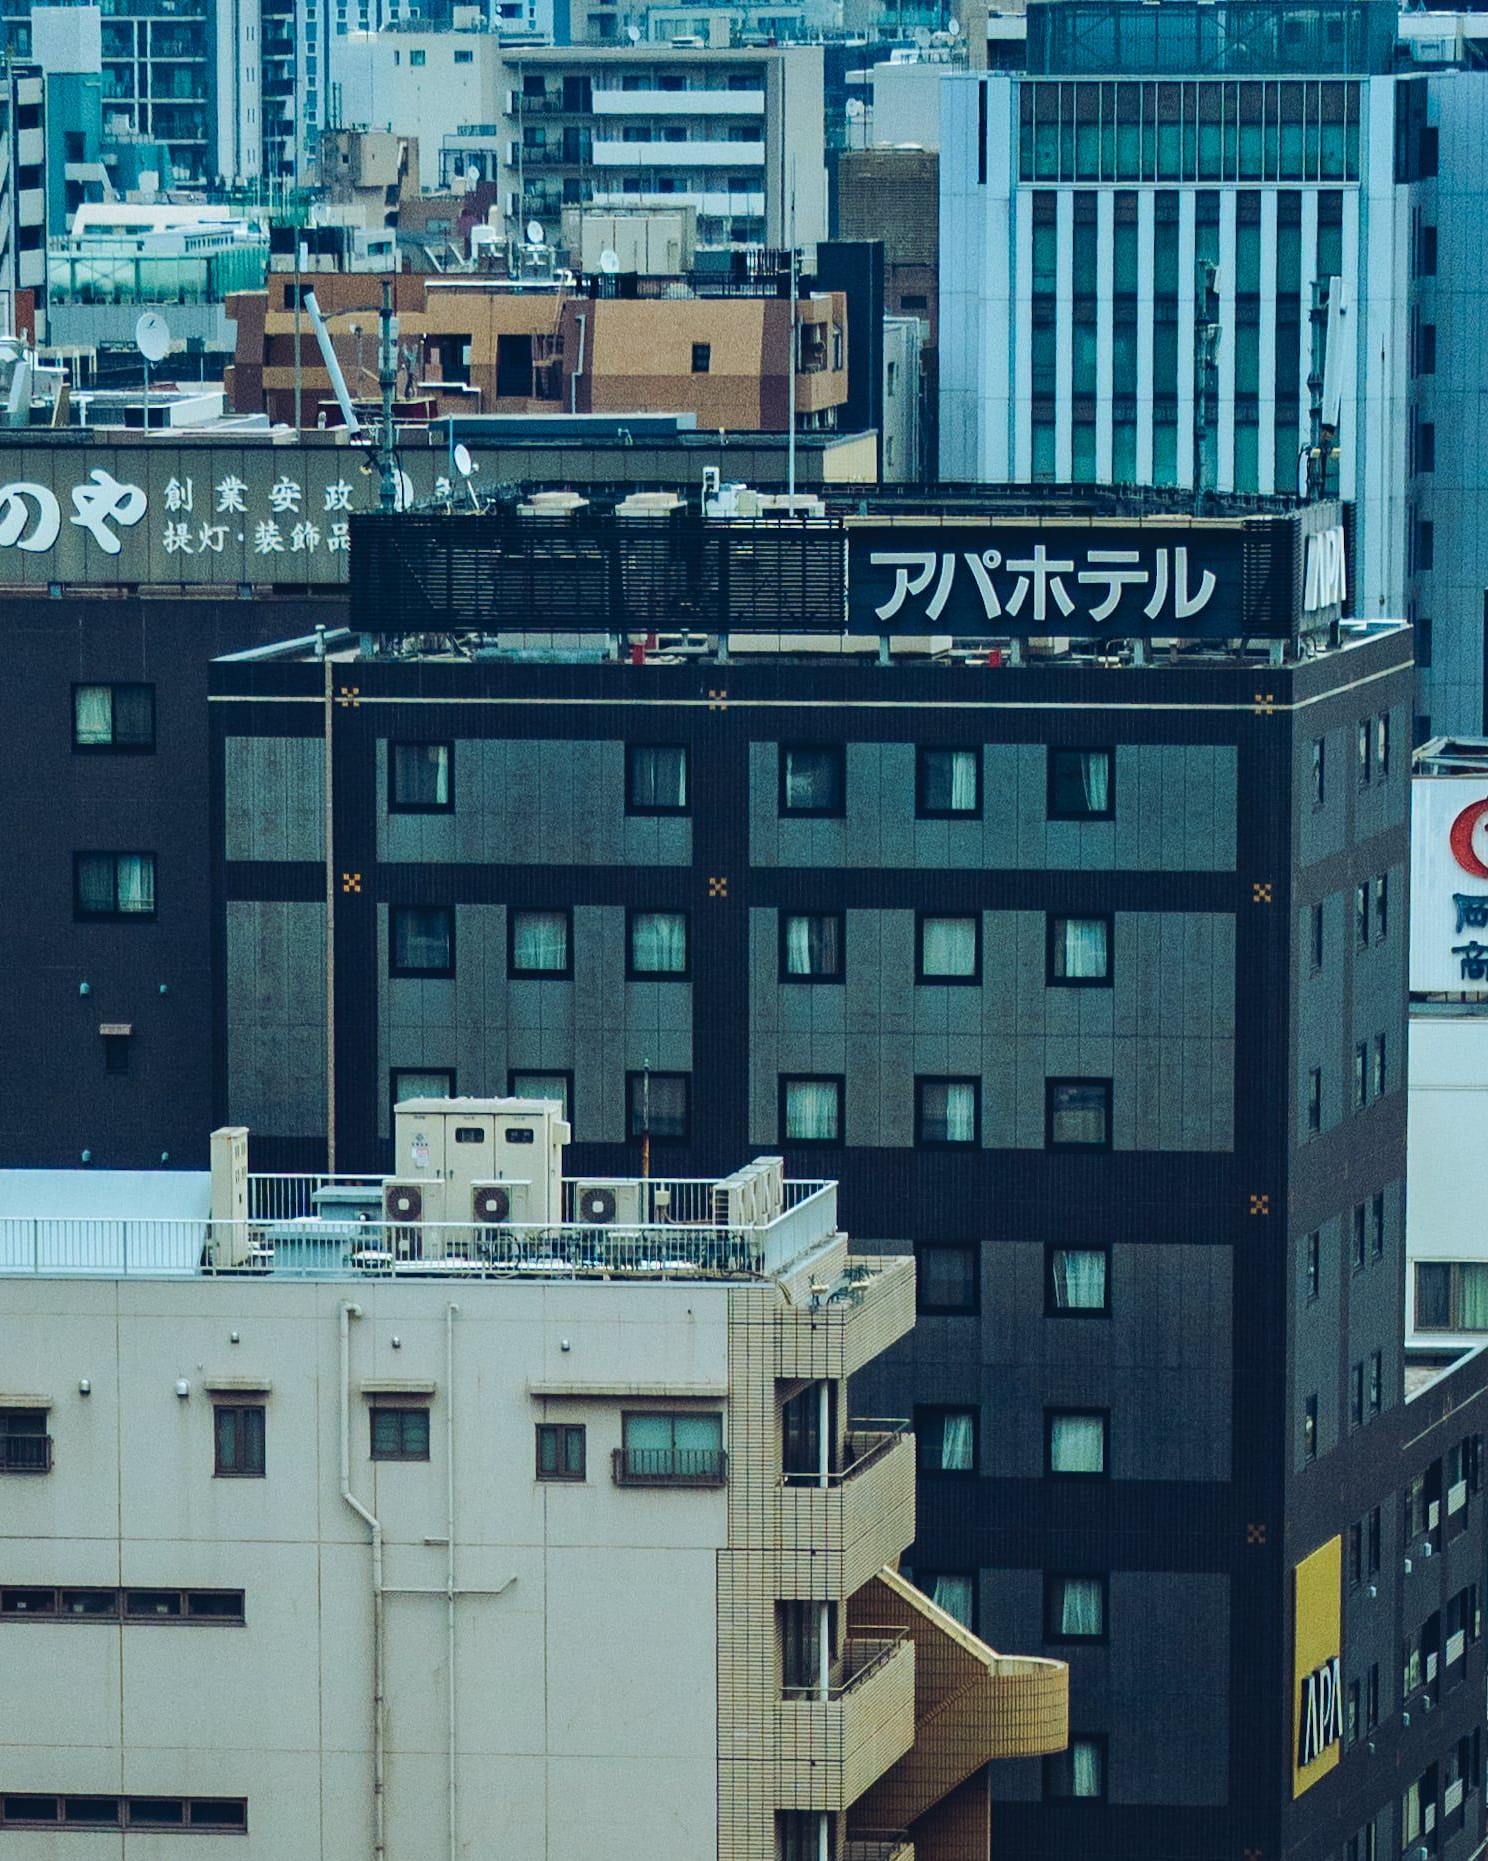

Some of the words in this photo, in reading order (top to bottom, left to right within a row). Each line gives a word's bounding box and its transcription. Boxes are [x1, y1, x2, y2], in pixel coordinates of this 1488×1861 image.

[163, 474, 354, 514] 創業安政
[869, 544, 1217, 622] アパホテル
